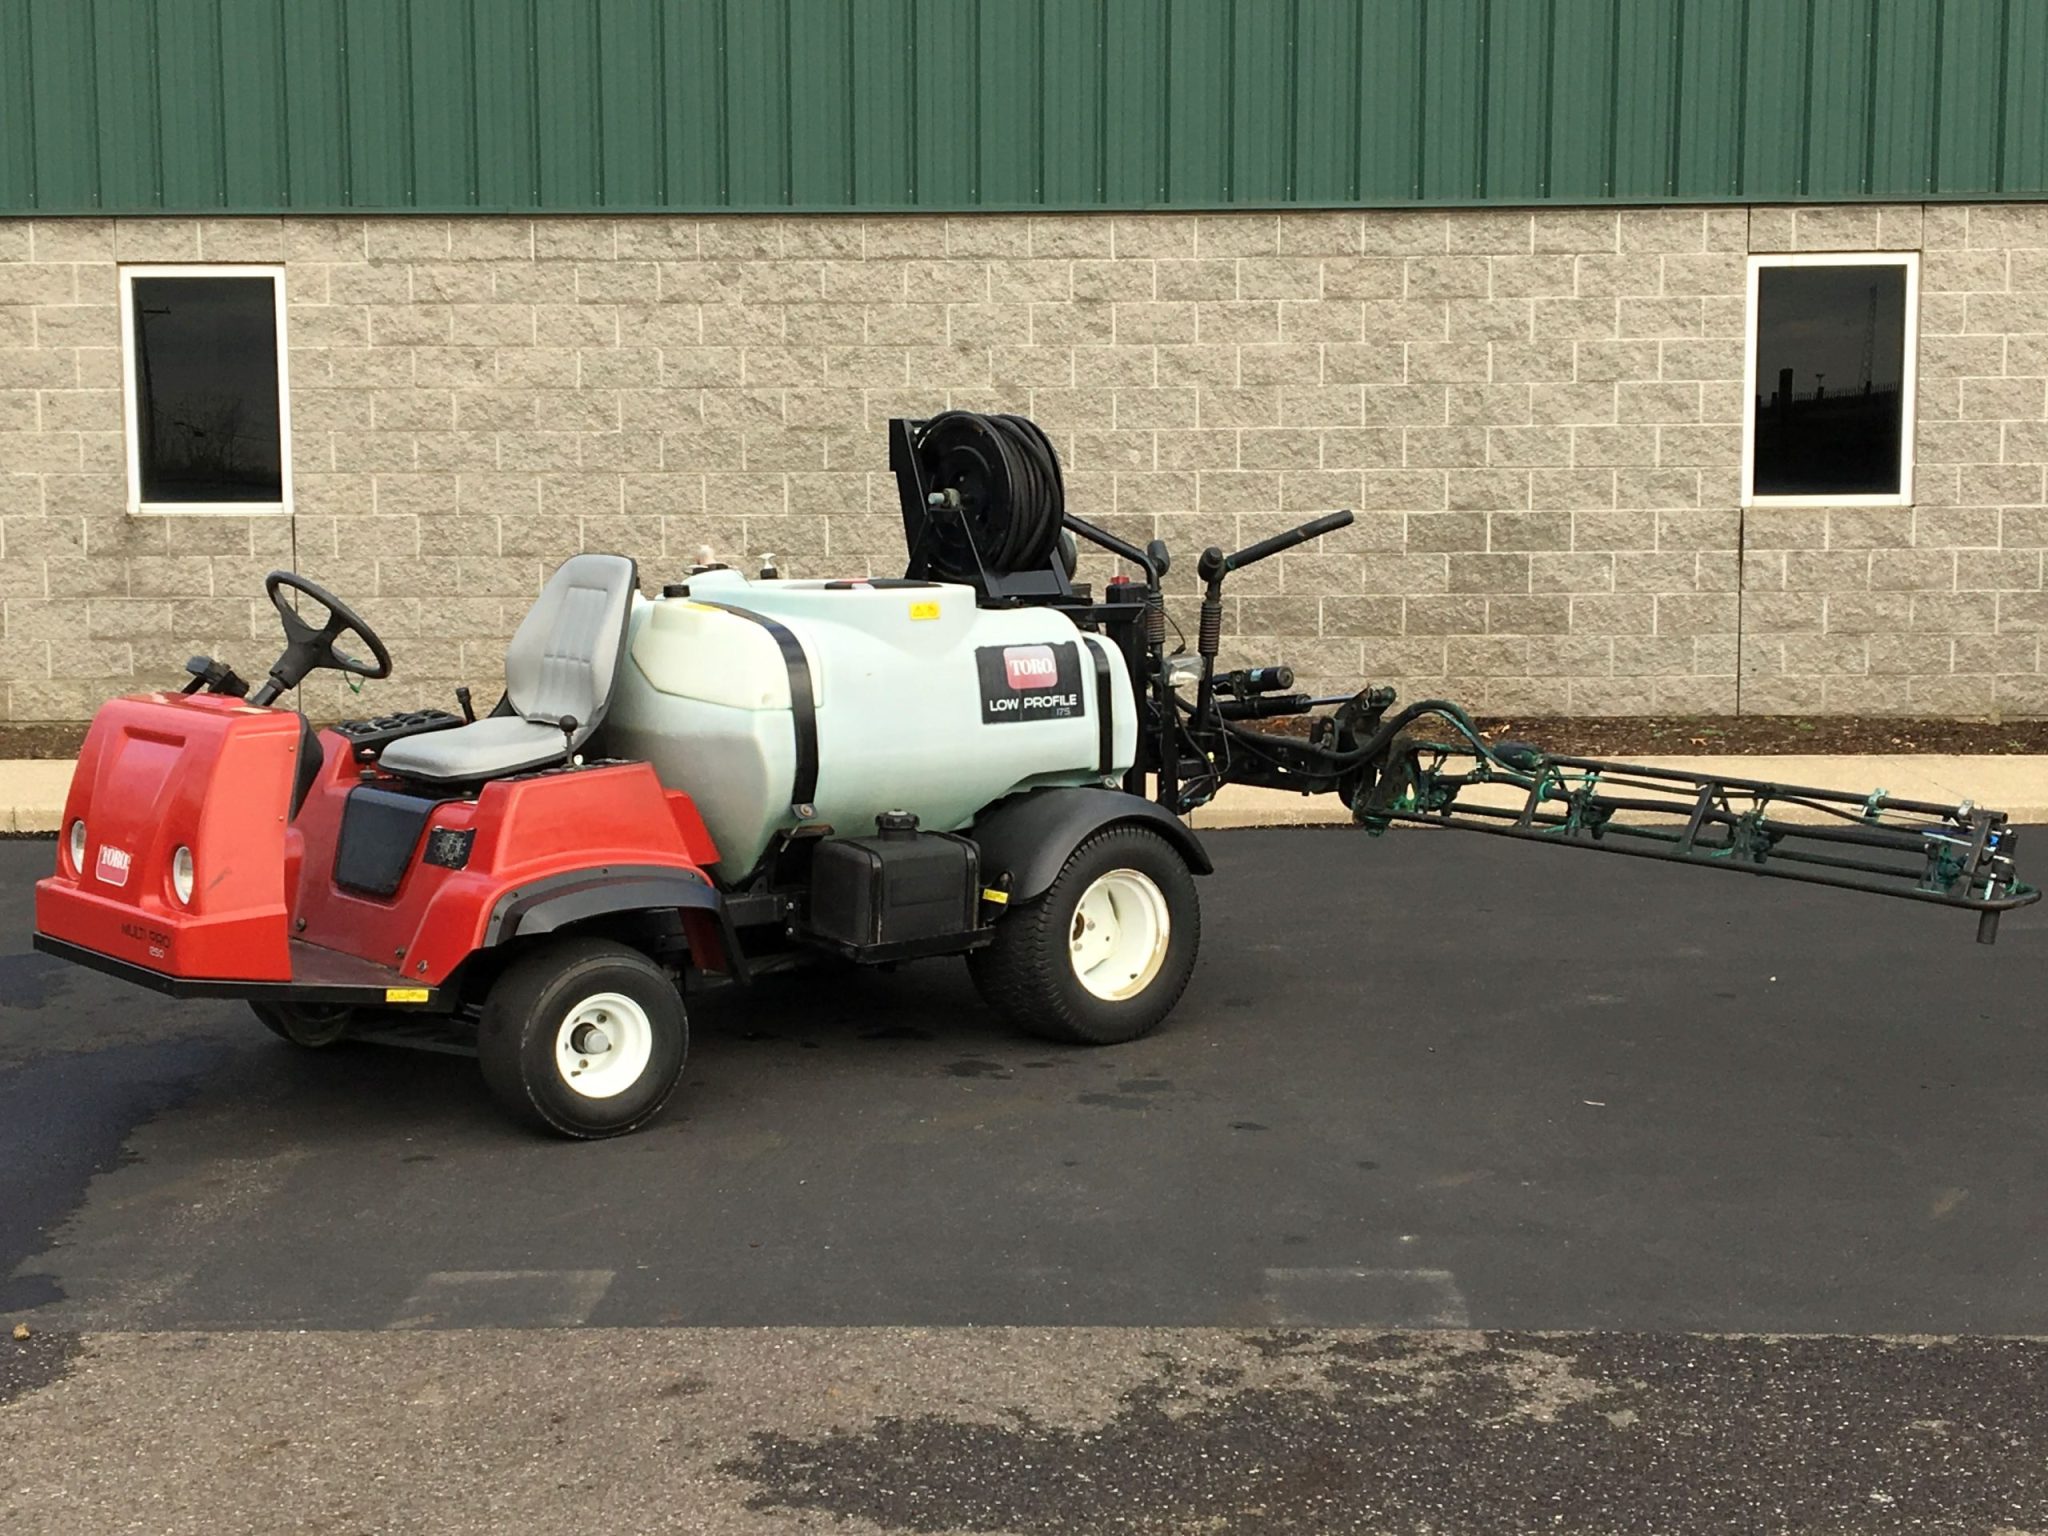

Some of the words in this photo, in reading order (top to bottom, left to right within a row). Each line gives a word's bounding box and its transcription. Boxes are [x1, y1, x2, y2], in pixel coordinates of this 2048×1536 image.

[1010, 658, 1053, 676] TORO
[989, 698, 1020, 712] LOW
[1023, 694, 1078, 709] PROFILE
[101, 846, 130, 870] TORO
[149, 930, 171, 948] PRO
